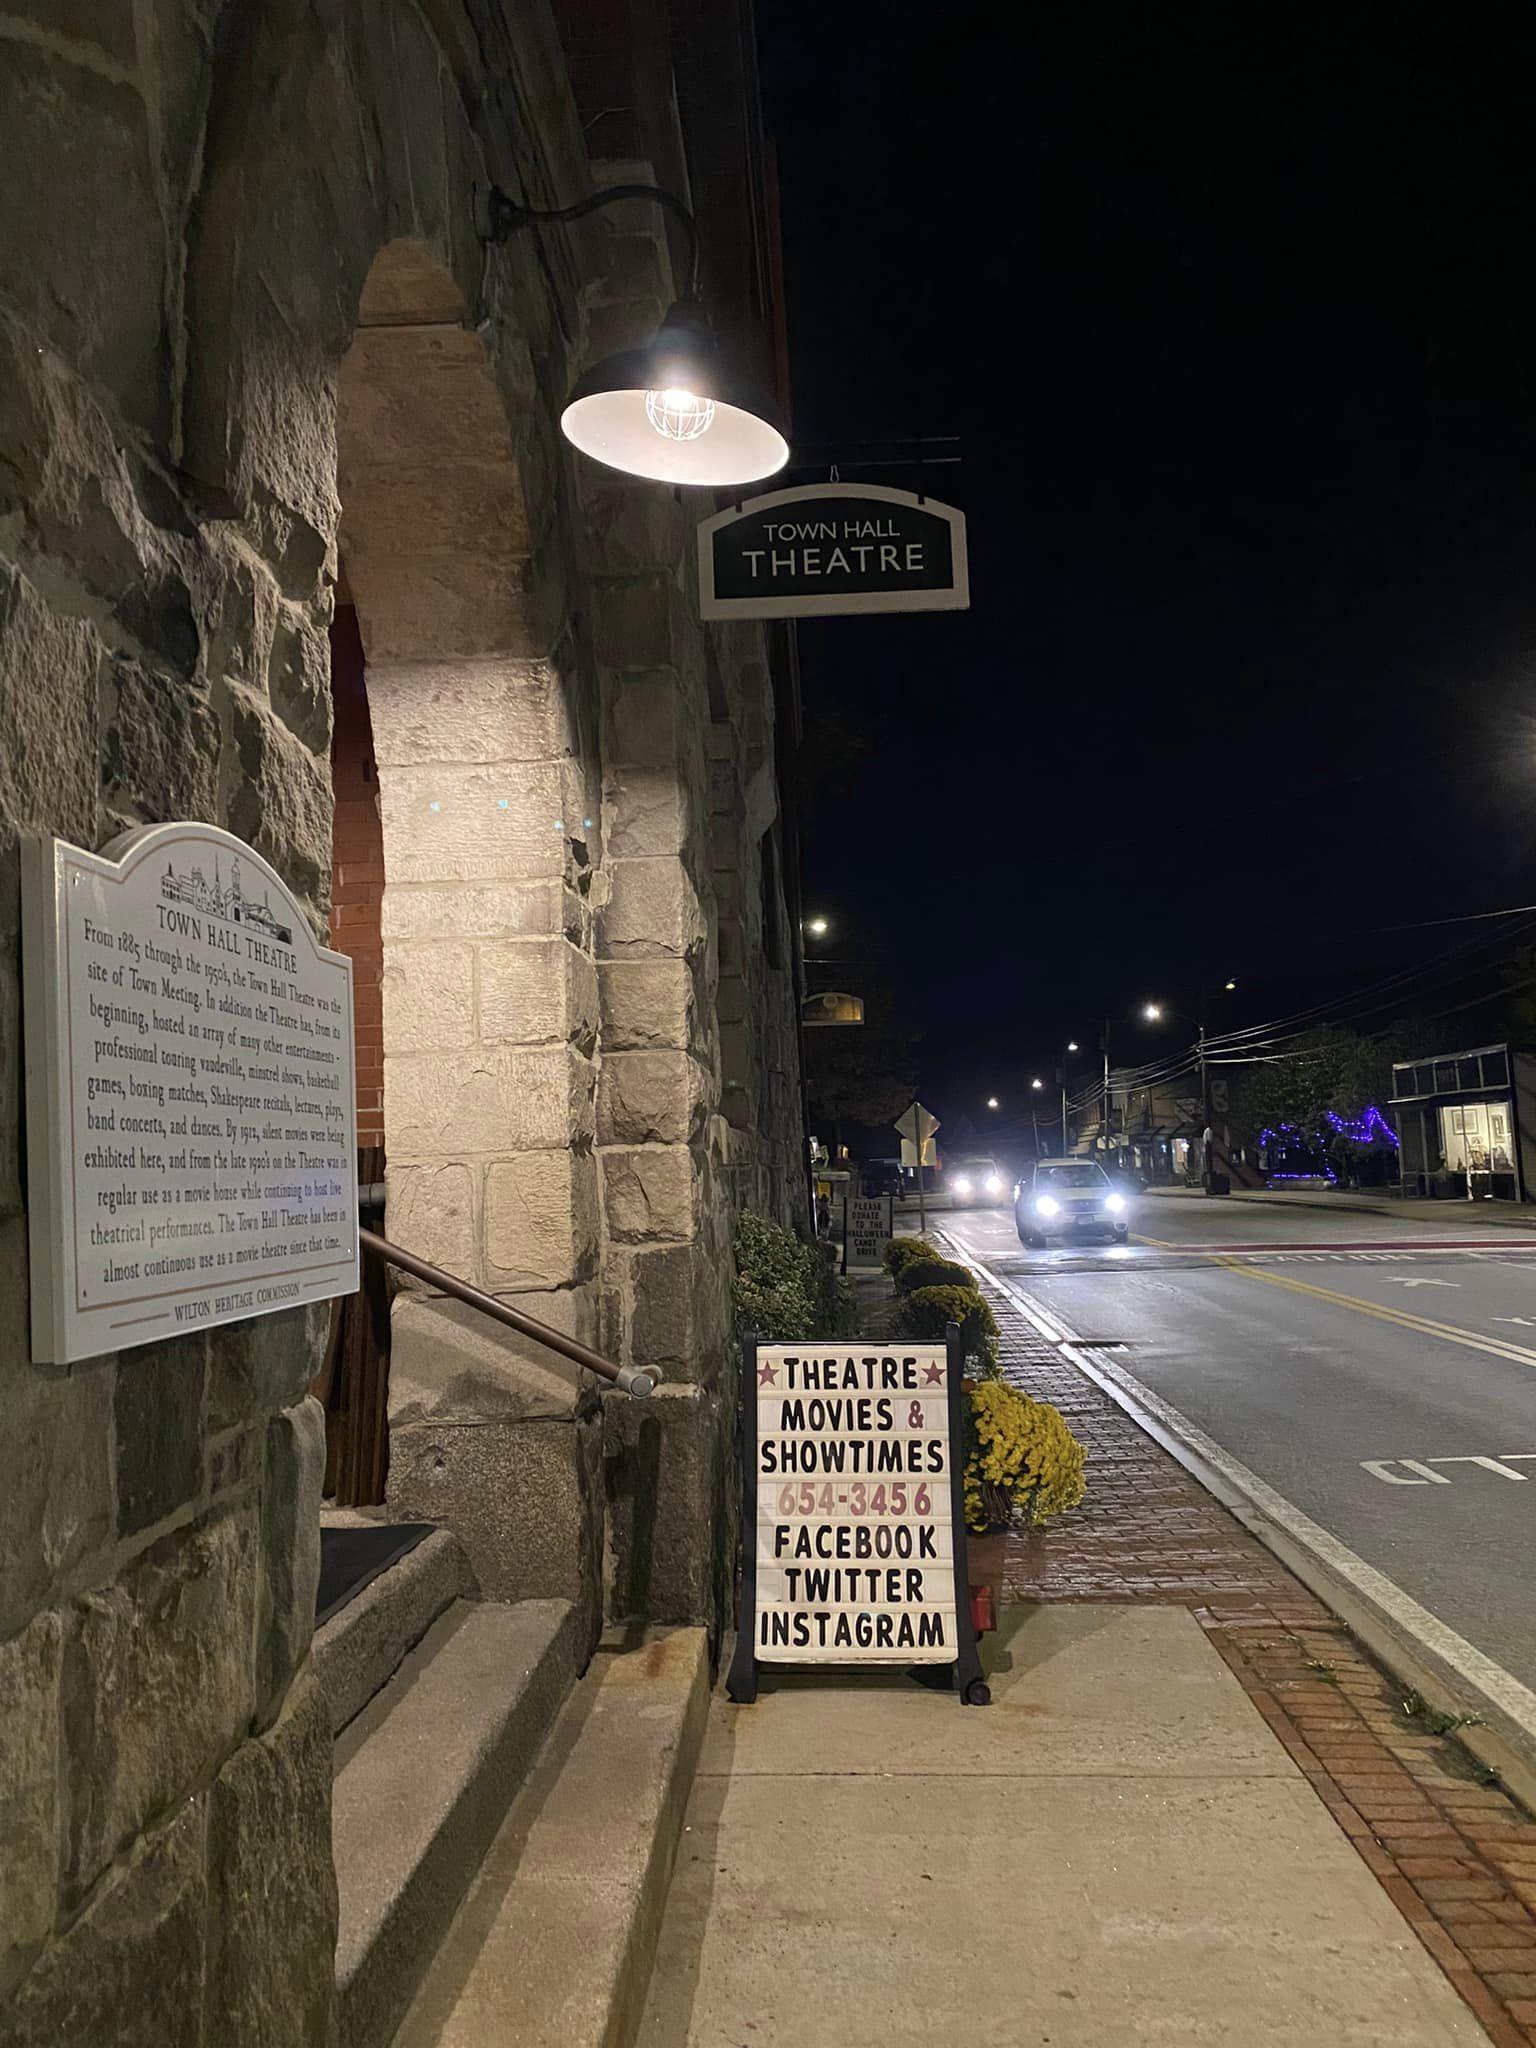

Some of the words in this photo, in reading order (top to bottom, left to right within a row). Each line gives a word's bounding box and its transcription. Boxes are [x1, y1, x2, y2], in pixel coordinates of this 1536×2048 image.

[763, 522, 836, 542] TOWN
[844, 519, 901, 539] HALL
[742, 543, 924, 578] THEATRE
[156, 904, 201, 941] TOWN
[207, 924, 240, 955] HALL
[245, 937, 297, 974] THEATRE
[84, 918, 113, 948] From
[118, 931, 141, 963] 1885
[145, 939, 182, 974] through
[186, 953, 201, 974] the
[233, 968, 246, 987] the
[247, 971, 268, 994] Town
[271, 978, 286, 999] Hall
[288, 984, 315, 1007] Theatre
[317, 999, 329, 1011] was
[331, 998, 341, 1015] the
[88, 961, 108, 982] site
[112, 965, 125, 987] of
[129, 967, 157, 996] Town
[161, 977, 202, 1013] Meeting.
[206, 988, 215, 1010] In
[219, 994, 252, 1019] addition
[255, 1003, 267, 1022] the
[269, 1005, 298, 1029] Theatre
[315, 1019, 331, 1037] from
[89, 993, 149, 1034] beginning,
[152, 1009, 184, 1035] hosted
[188, 1024, 199, 1038] an
[202, 1026, 224, 1049] array
[227, 1026, 237, 1046] of
[240, 1035, 260, 1056] many
[263, 1035, 283, 1055] other
[95, 1036, 157, 1064] professional
[161, 1049, 196, 1077] touring
[200, 1054, 245, 1080] vaudeville,
[248, 1064, 279, 1082] minstrel
[88, 1077, 126, 1100] games,
[129, 1073, 164, 1107] boxing
[168, 1082, 207, 1108] matches,
[210, 1085, 260, 1114] Shakespeare
[87, 1106, 115, 1131] band
[120, 1117, 166, 1139] concerts,
[170, 1114, 187, 1135] and
[191, 1115, 222, 1137] dances.
[226, 1118, 237, 1144] By
[262, 1120, 282, 1139] silent
[285, 1127, 308, 1141] movies
[310, 1130, 325, 1142] were
[327, 1126, 344, 1149] being
[84, 1145, 136, 1169] exhibited
[140, 1146, 165, 1174] here,
[169, 1148, 186, 1168] and
[189, 1149, 211, 1168] from
[214, 1150, 227, 1168] the
[230, 1149, 246, 1168] late
[273, 1158, 282, 1168] on
[284, 1151, 296, 1168] the
[298, 1151, 324, 1168] Theatre
[327, 1158, 339, 1168] was
[97, 1183, 137, 1214] regular
[142, 1190, 158, 1204] use
[162, 1190, 171, 1203] as
[175, 1189, 181, 1203] a
[184, 1187, 210, 1202] movie
[213, 1181, 237, 1201] house
[240, 1180, 261, 1199] while
[264, 1184, 302, 1203] continuing
[304, 1184, 312, 1196] to
[314, 1179, 327, 1196] host
[329, 1179, 341, 1195] live
[854, 1201, 881, 1210] PLEASE
[91, 1219, 145, 1245] theatrical
[149, 1217, 214, 1248] performances.
[218, 1213, 235, 1232] The
[237, 1211, 259, 1231] Town
[261, 1210, 277, 1229] Hall
[280, 1209, 308, 1227] Theatre
[310, 1207, 321, 1224] has
[323, 1206, 338, 1223] been
[870, 1220, 883, 1228] THE
[103, 1259, 139, 1282] almost
[144, 1256, 195, 1277] continuous
[199, 1254, 213, 1269] use
[217, 1253, 225, 1266] as
[229, 1252, 233, 1264] a
[236, 1247, 259, 1262] movie
[261, 1241, 287, 1259] theatre
[290, 1240, 307, 1255] since
[309, 1235, 322, 1252] that
[174, 1300, 211, 1321] WILTON
[215, 1291, 253, 1314] HERITAGE
[257, 1281, 300, 1304] COMMISSION
[783, 1356, 918, 1390] THEATRE
[781, 1398, 893, 1431] MOVIES
[908, 1399, 924, 1430] &
[761, 1439, 944, 1474] SHOWTIMES
[778, 1482, 932, 1516] 654-3456
[774, 1524, 937, 1559] FACEBOOK
[785, 1568, 924, 1602] TWITTER
[761, 1611, 945, 1648] INSTAGRAM
